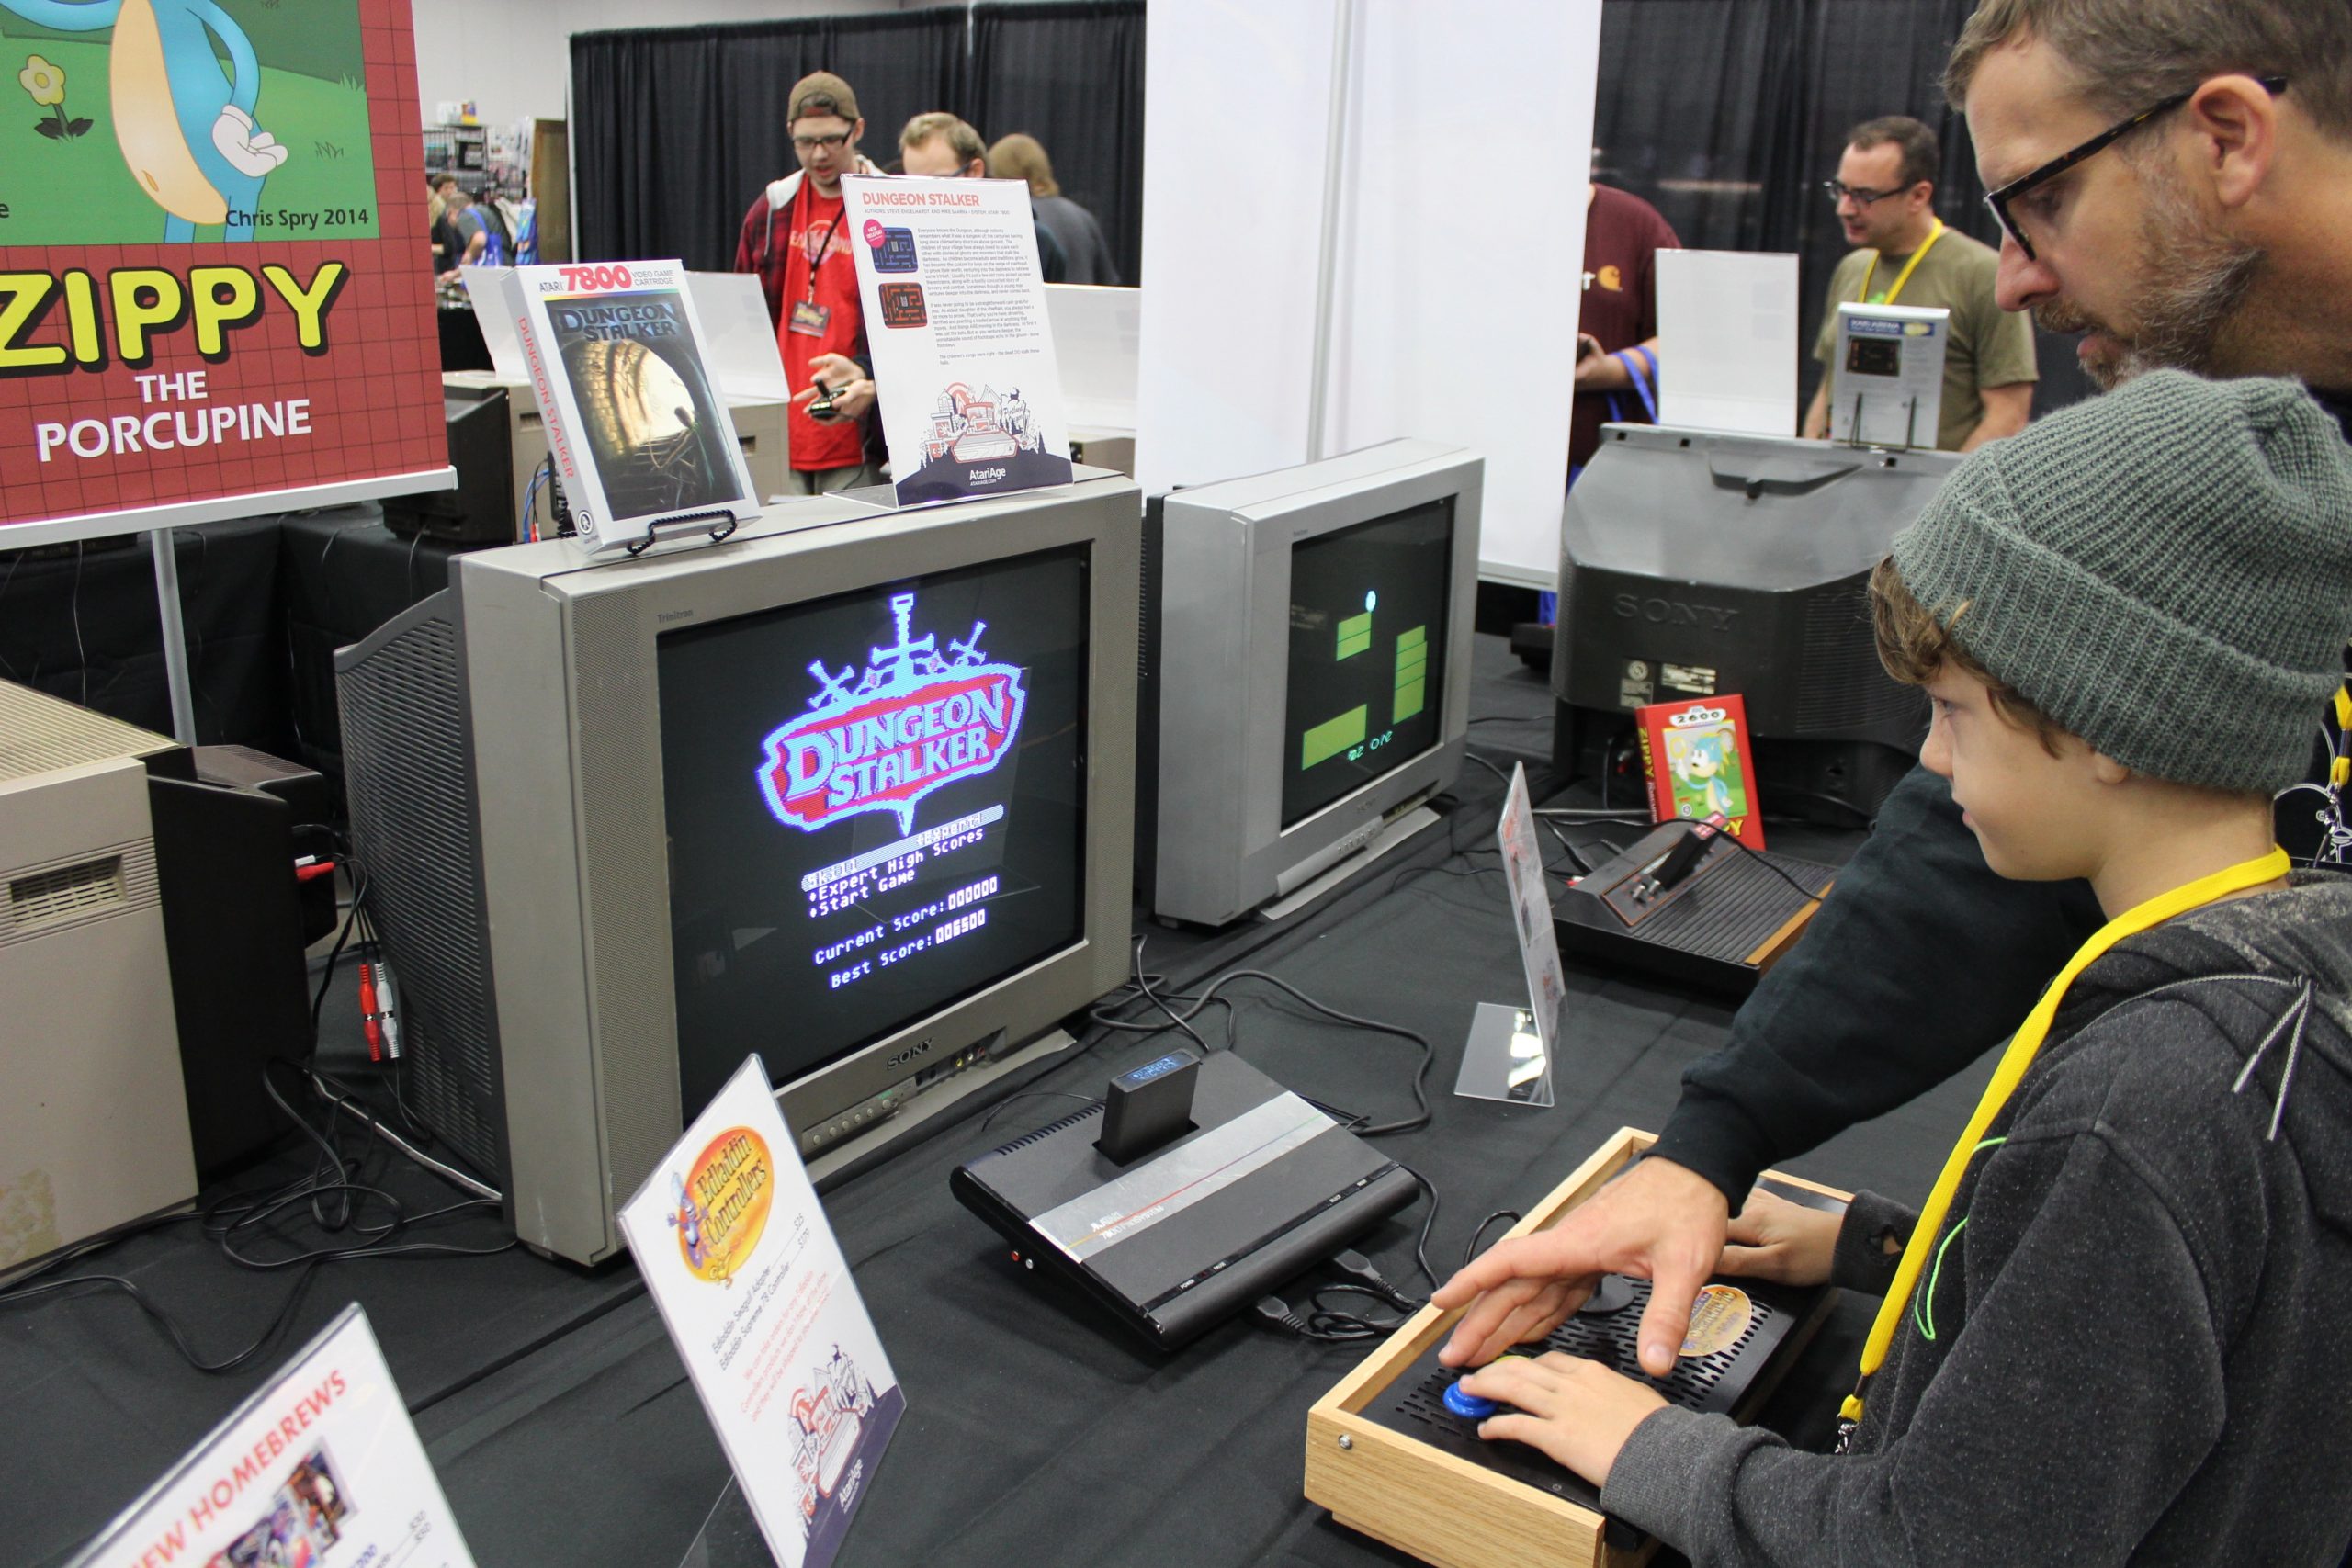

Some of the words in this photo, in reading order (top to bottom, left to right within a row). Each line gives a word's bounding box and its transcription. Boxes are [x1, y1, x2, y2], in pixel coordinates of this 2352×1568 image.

[862, 192, 925, 206] DUNGEON
[929, 193, 979, 206] STALKER
[226, 209, 274, 227] Chris
[279, 209, 319, 230] Spry
[324, 209, 369, 225] 2014
[539, 282, 563, 292] ATARI
[559, 265, 632, 291] 7800
[634, 277, 673, 286] CARTRIDGE
[0, 261, 348, 377] ZIPPY
[558, 304, 679, 333] DUNGEON
[583, 321, 676, 341] STALKER
[134, 370, 209, 402] THE
[518, 317, 550, 405] DUNGEON
[547, 407, 574, 478] STALKER
[37, 399, 311, 462] PORCUPINE
[969, 467, 1006, 481] AtariAge
[657, 610, 694, 623] Trinitron
[1614, 593, 1739, 632] SONY
[1677, 711, 1720, 724] 2600
[782, 683, 1006, 802] DUNGEON
[1639, 728, 1655, 777] ZIPPY
[826, 726, 992, 807] STALKER
[819, 867, 878, 900] Expert
[888, 851, 924, 874] High
[933, 829, 984, 857] Scores
[819, 886, 869, 916] Start
[878, 869, 915, 893] Game
[814, 924, 885, 964] Current
[831, 961, 871, 989] Best
[887, 1037, 936, 1071] SONY
[696, 1135, 752, 1206] Edladdin
[704, 1158, 767, 1245] Controllers
[189, 1369, 346, 1532] HOMEBREWS
[838, 1458, 863, 1508] AtariAge
